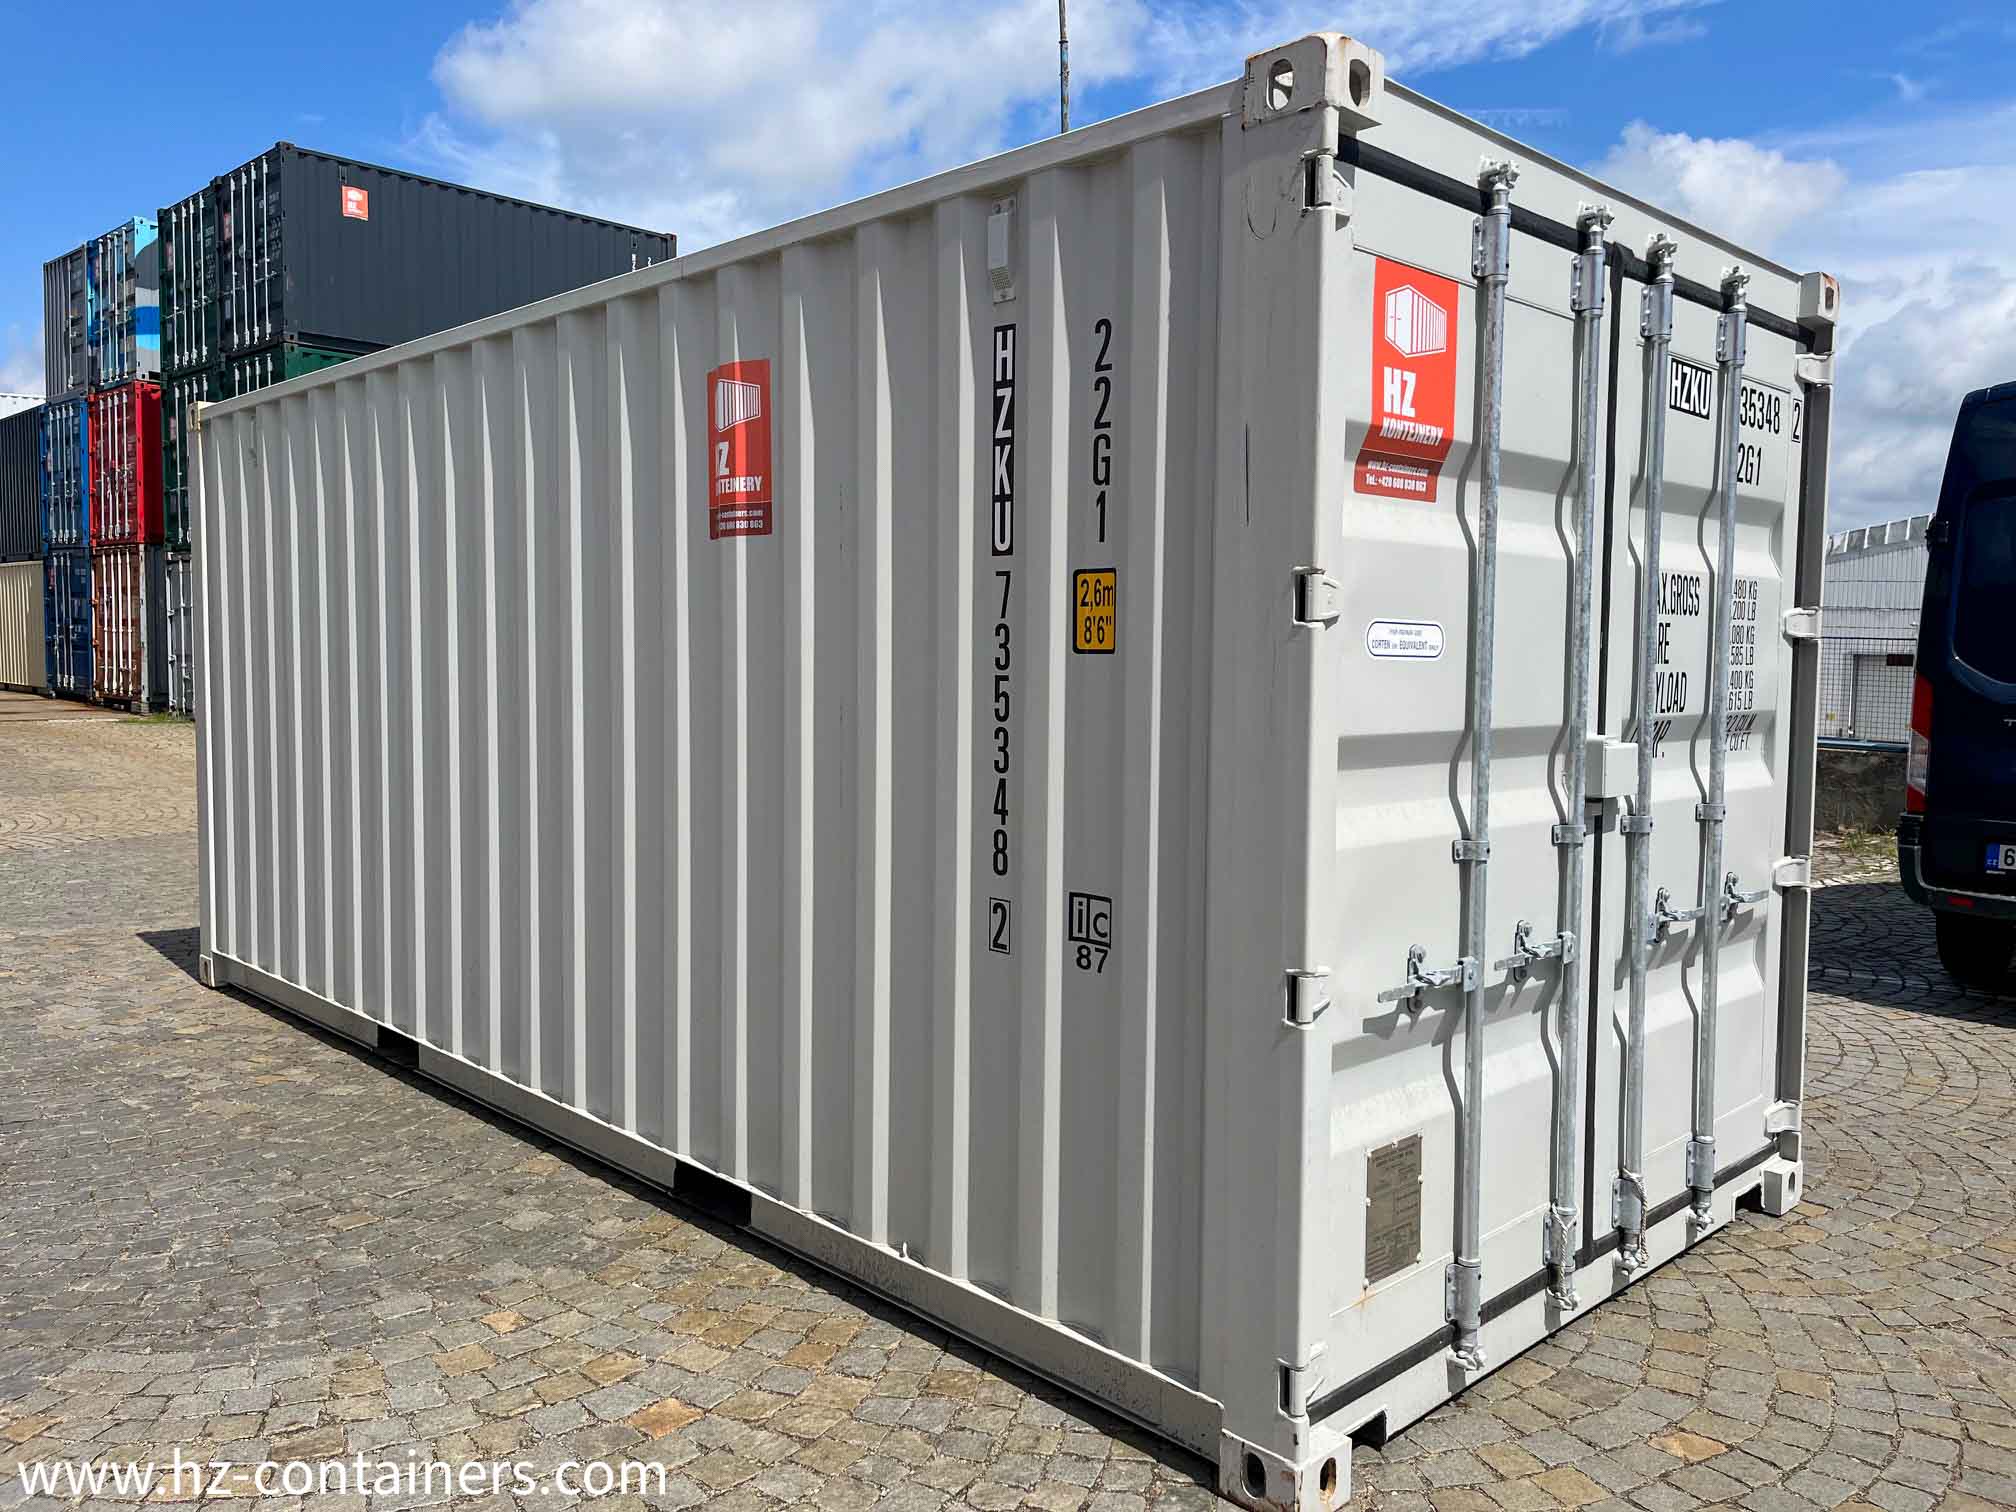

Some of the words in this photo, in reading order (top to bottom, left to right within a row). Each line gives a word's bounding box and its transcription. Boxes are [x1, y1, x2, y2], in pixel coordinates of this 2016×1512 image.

[1383, 366, 1416, 417] HZ
[1670, 360, 1712, 418] HZKU
[1740, 386, 1780, 435] 35348
[1793, 402, 1800, 440] 2
[994, 327, 1014, 553] HZKU
[1093, 318, 1112, 543] 22G1
[1737, 443, 1762, 486] 2G1
[1080, 578, 1114, 611] 2,6m
[1657, 572, 1700, 617] X.GROSS
[1747, 601, 1756, 621] LB
[1083, 615, 1112, 645] 8'6"
[1656, 622, 1671, 664] RE
[1745, 646, 1754, 666] LB
[1655, 671, 1687, 713] YLOAD
[1744, 690, 1753, 710] LB
[993, 570, 1011, 876] 735348
[2004, 848, 2015, 866] 6
[991, 901, 1008, 951] 2
[1075, 945, 1109, 974] 87
